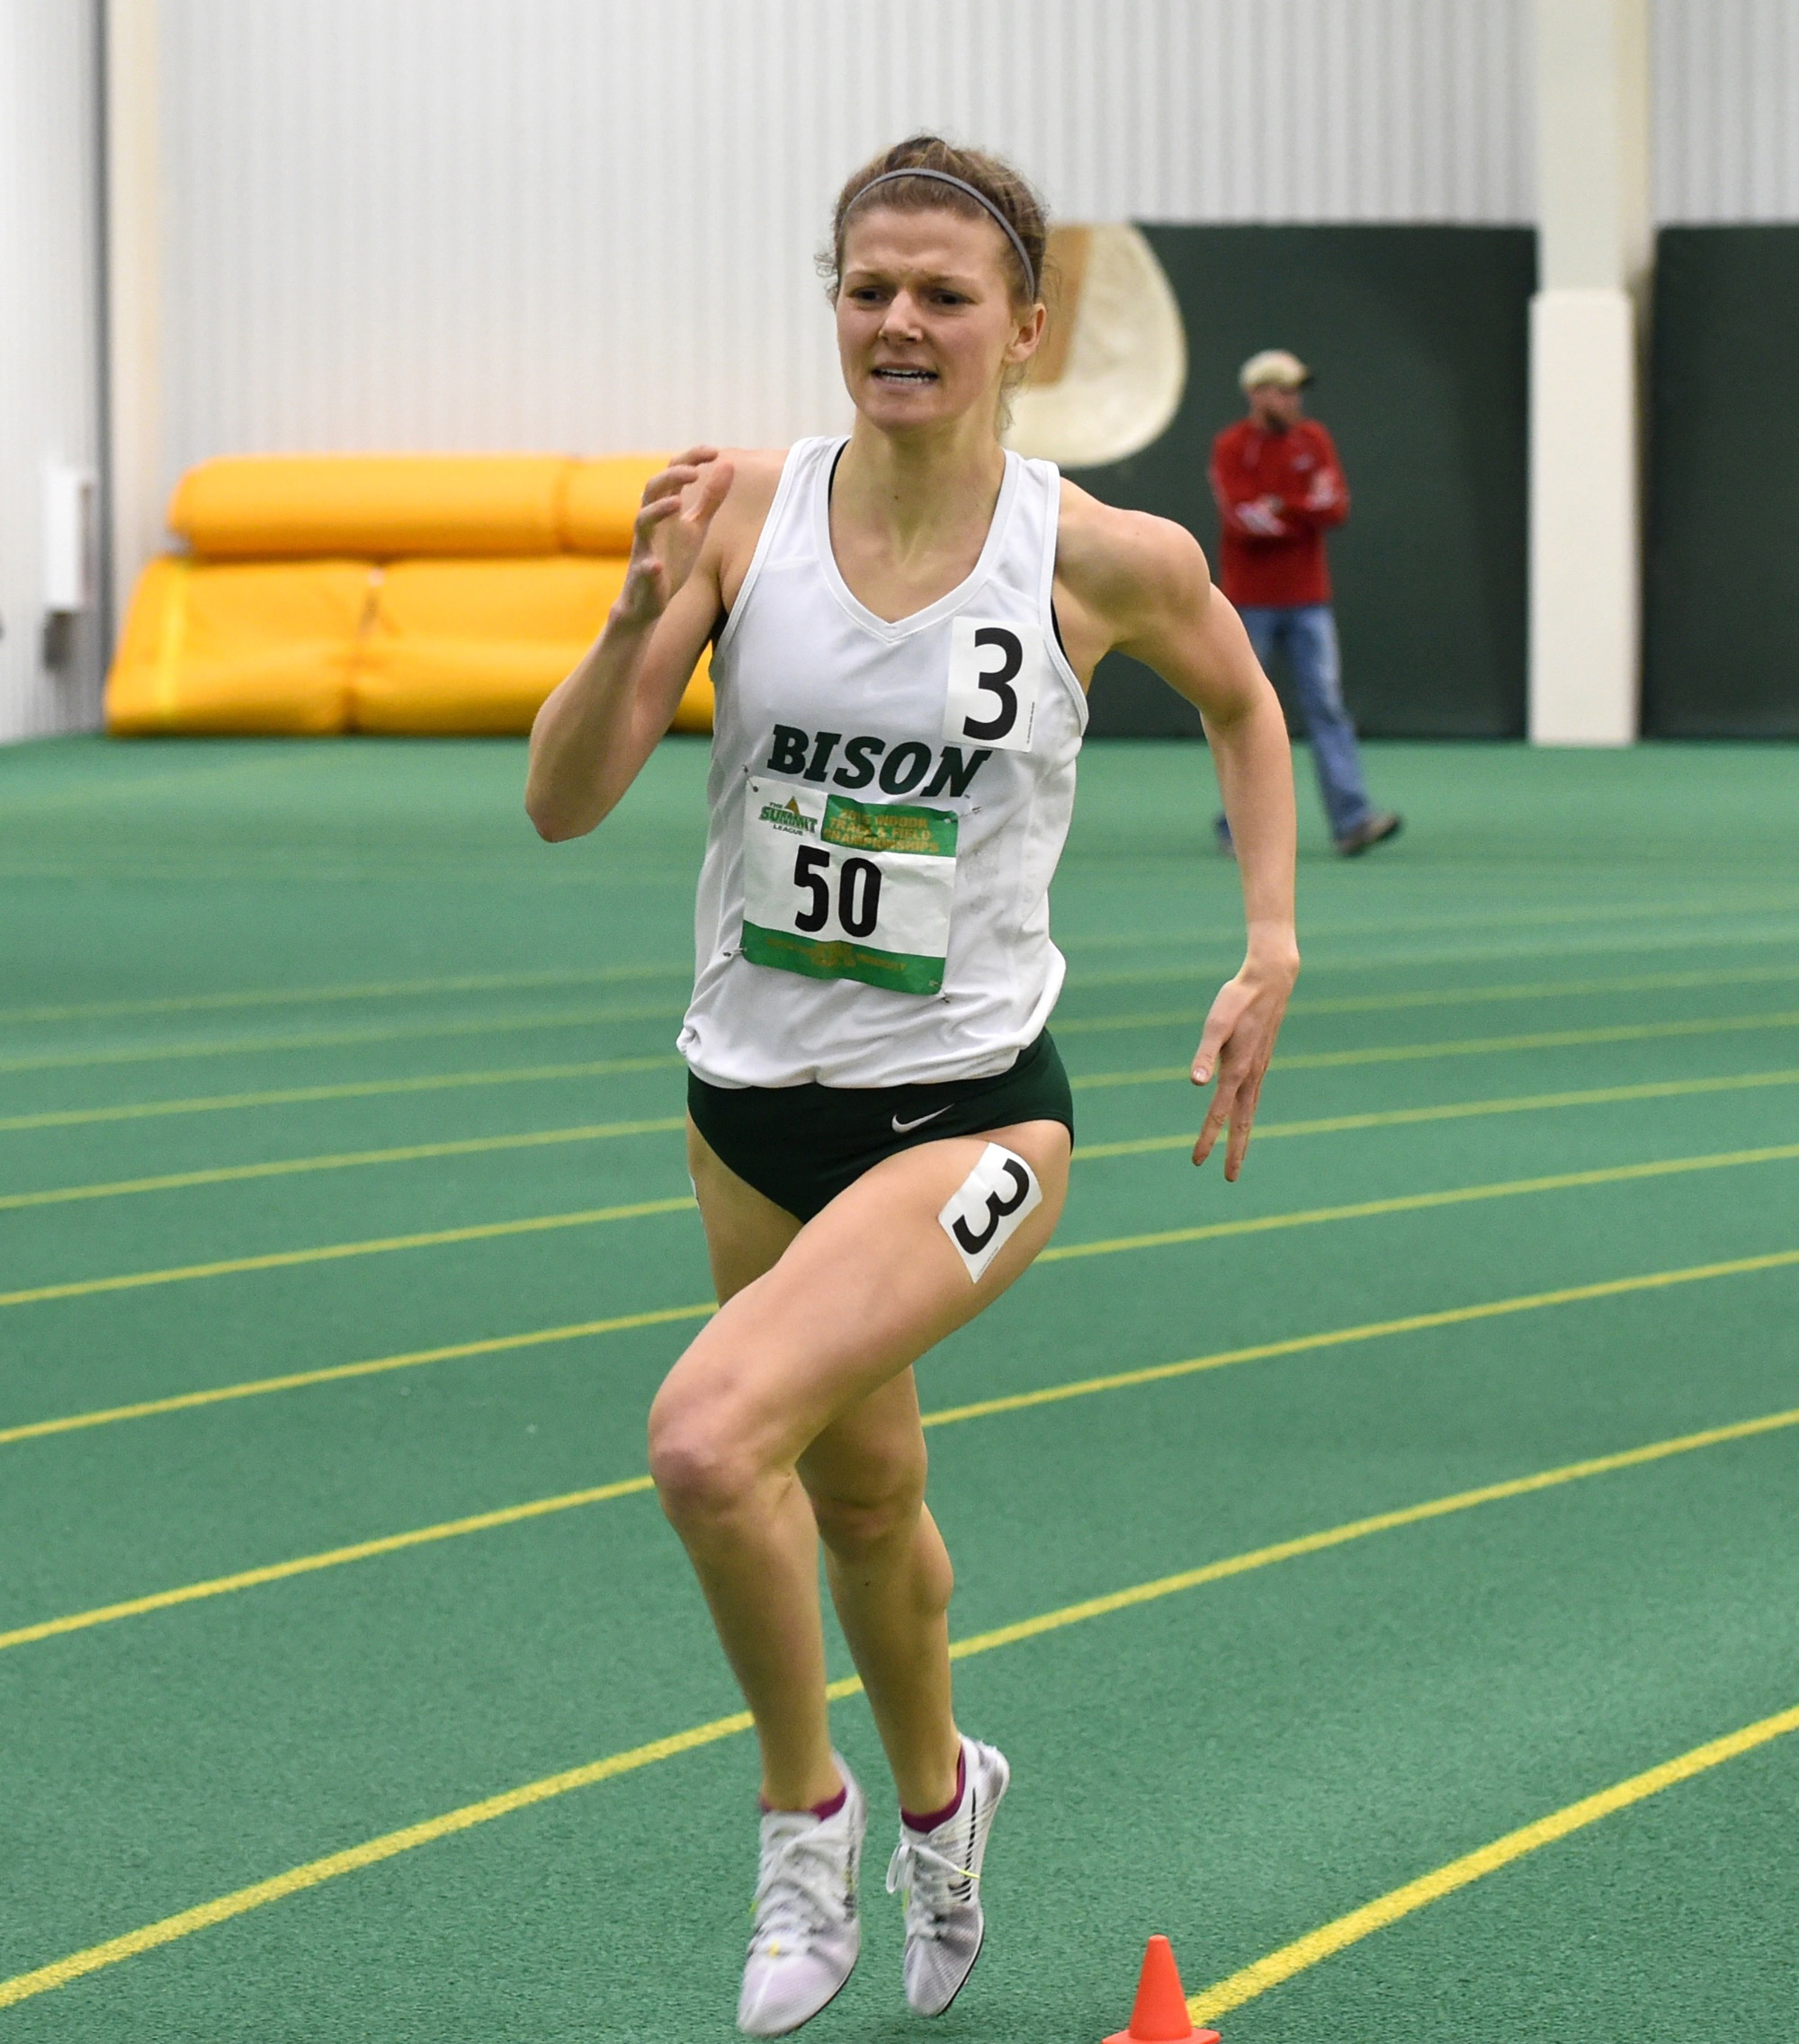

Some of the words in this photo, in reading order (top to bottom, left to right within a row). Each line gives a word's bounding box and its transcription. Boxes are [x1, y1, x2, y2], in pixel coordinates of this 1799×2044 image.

[962, 627, 1023, 741] 3
[767, 724, 993, 797] BISON
[758, 806, 819, 834] SUMMIT
[773, 824, 804, 836] LEAGUE
[891, 827, 931, 841] FIELD
[793, 844, 882, 938] 50
[952, 1157, 1030, 1255] 3
